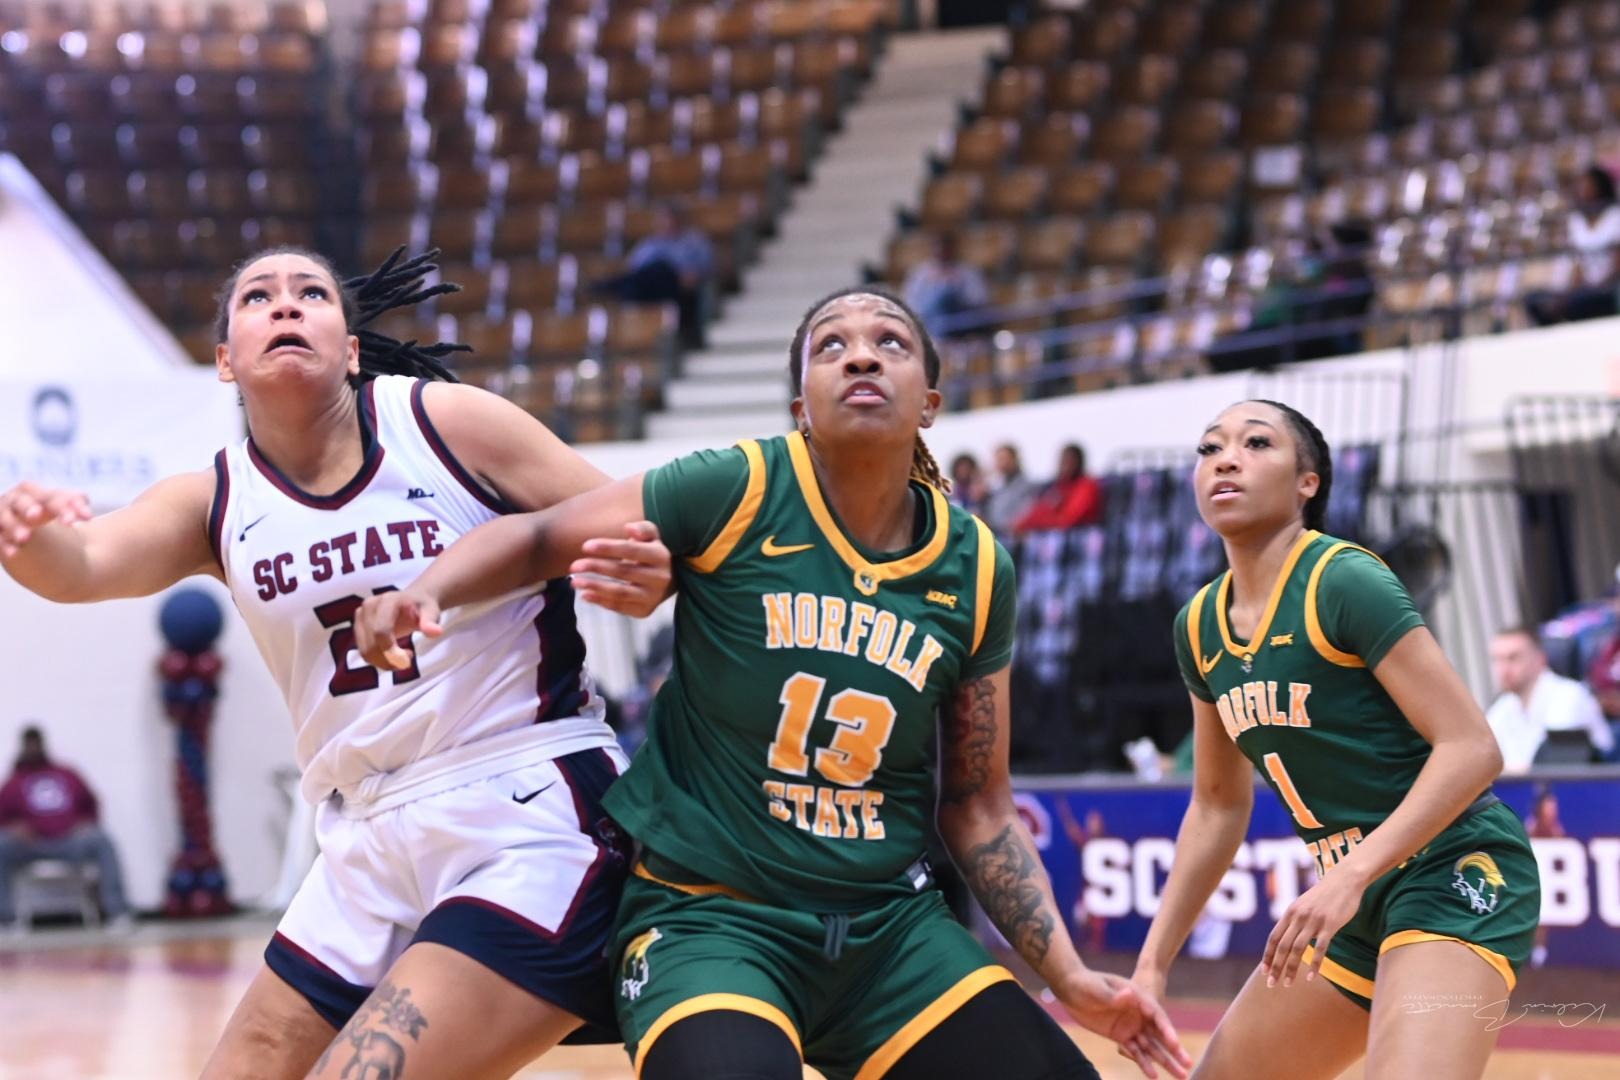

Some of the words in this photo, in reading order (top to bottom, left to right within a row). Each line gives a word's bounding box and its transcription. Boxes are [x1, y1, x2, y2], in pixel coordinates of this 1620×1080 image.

[253, 552, 297, 602] SC
[309, 519, 444, 583] STATE
[762, 592, 944, 693] NORFOLK
[767, 671, 898, 787] 13
[1216, 680, 1311, 743] ORFOLK
[762, 780, 886, 840] STATE
[1263, 752, 1325, 829] 1
[1082, 837, 1178, 918] SC
